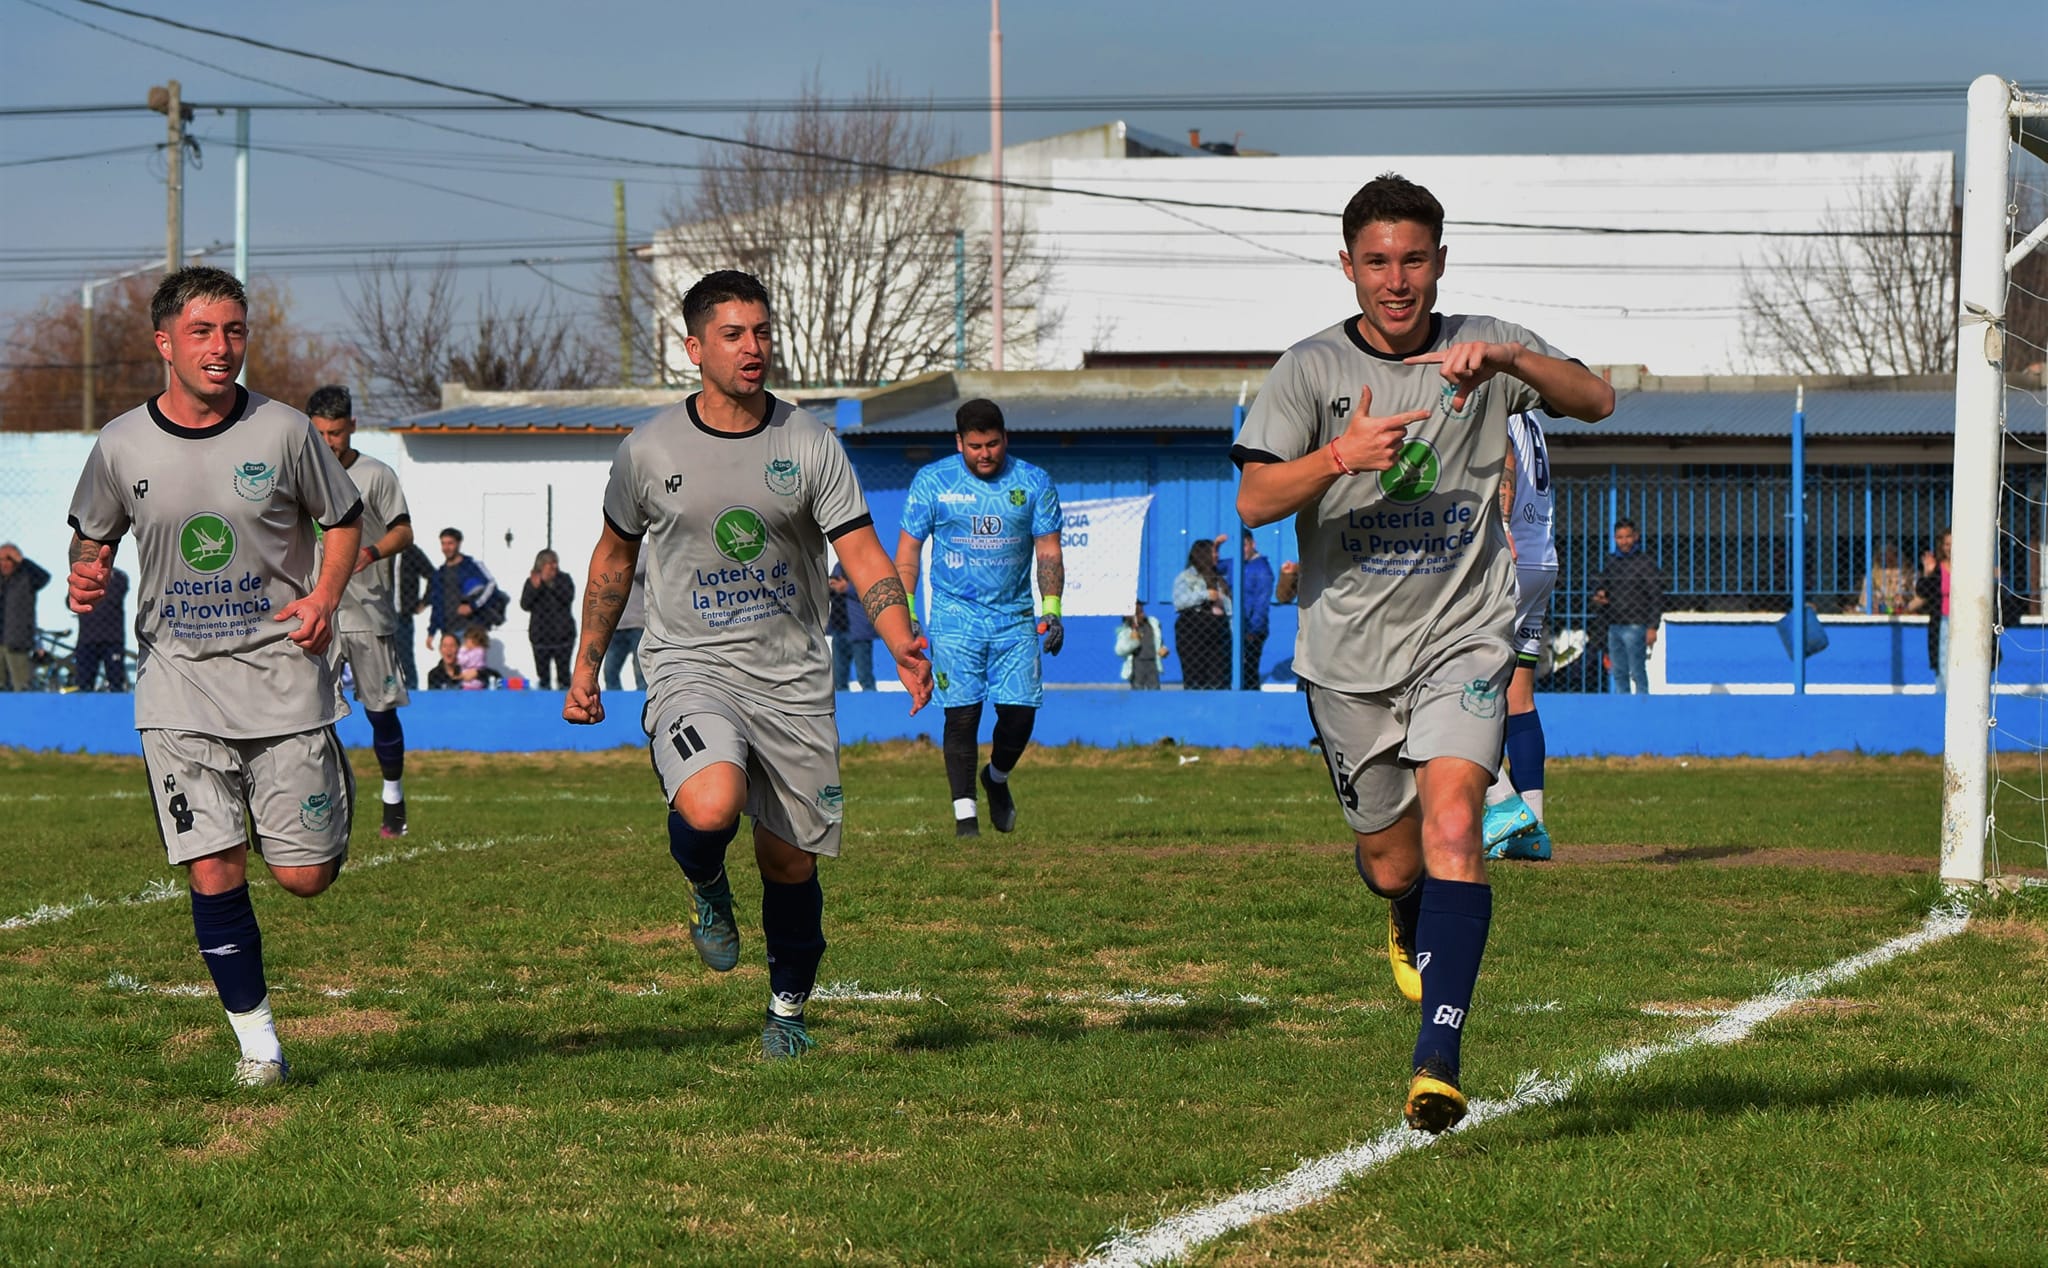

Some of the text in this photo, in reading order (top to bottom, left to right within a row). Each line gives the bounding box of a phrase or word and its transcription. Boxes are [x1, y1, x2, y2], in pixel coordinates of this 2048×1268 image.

[1349, 501, 1470, 529] Lotería de
[1341, 529, 1474, 555] la Provincia
[772, 560, 788, 579] de
[1361, 564, 1407, 576] Beneficios
[165, 571, 261, 596] Lotería de
[181, 595, 271, 619] Provincia
[692, 590, 710, 610] la
[708, 615, 752, 628] Beneficios
[754, 612, 771, 622] para
[216, 629, 234, 639] para
[671, 725, 706, 762] 11
[168, 792, 194, 834] 8
[1433, 1004, 1465, 1029] GO
